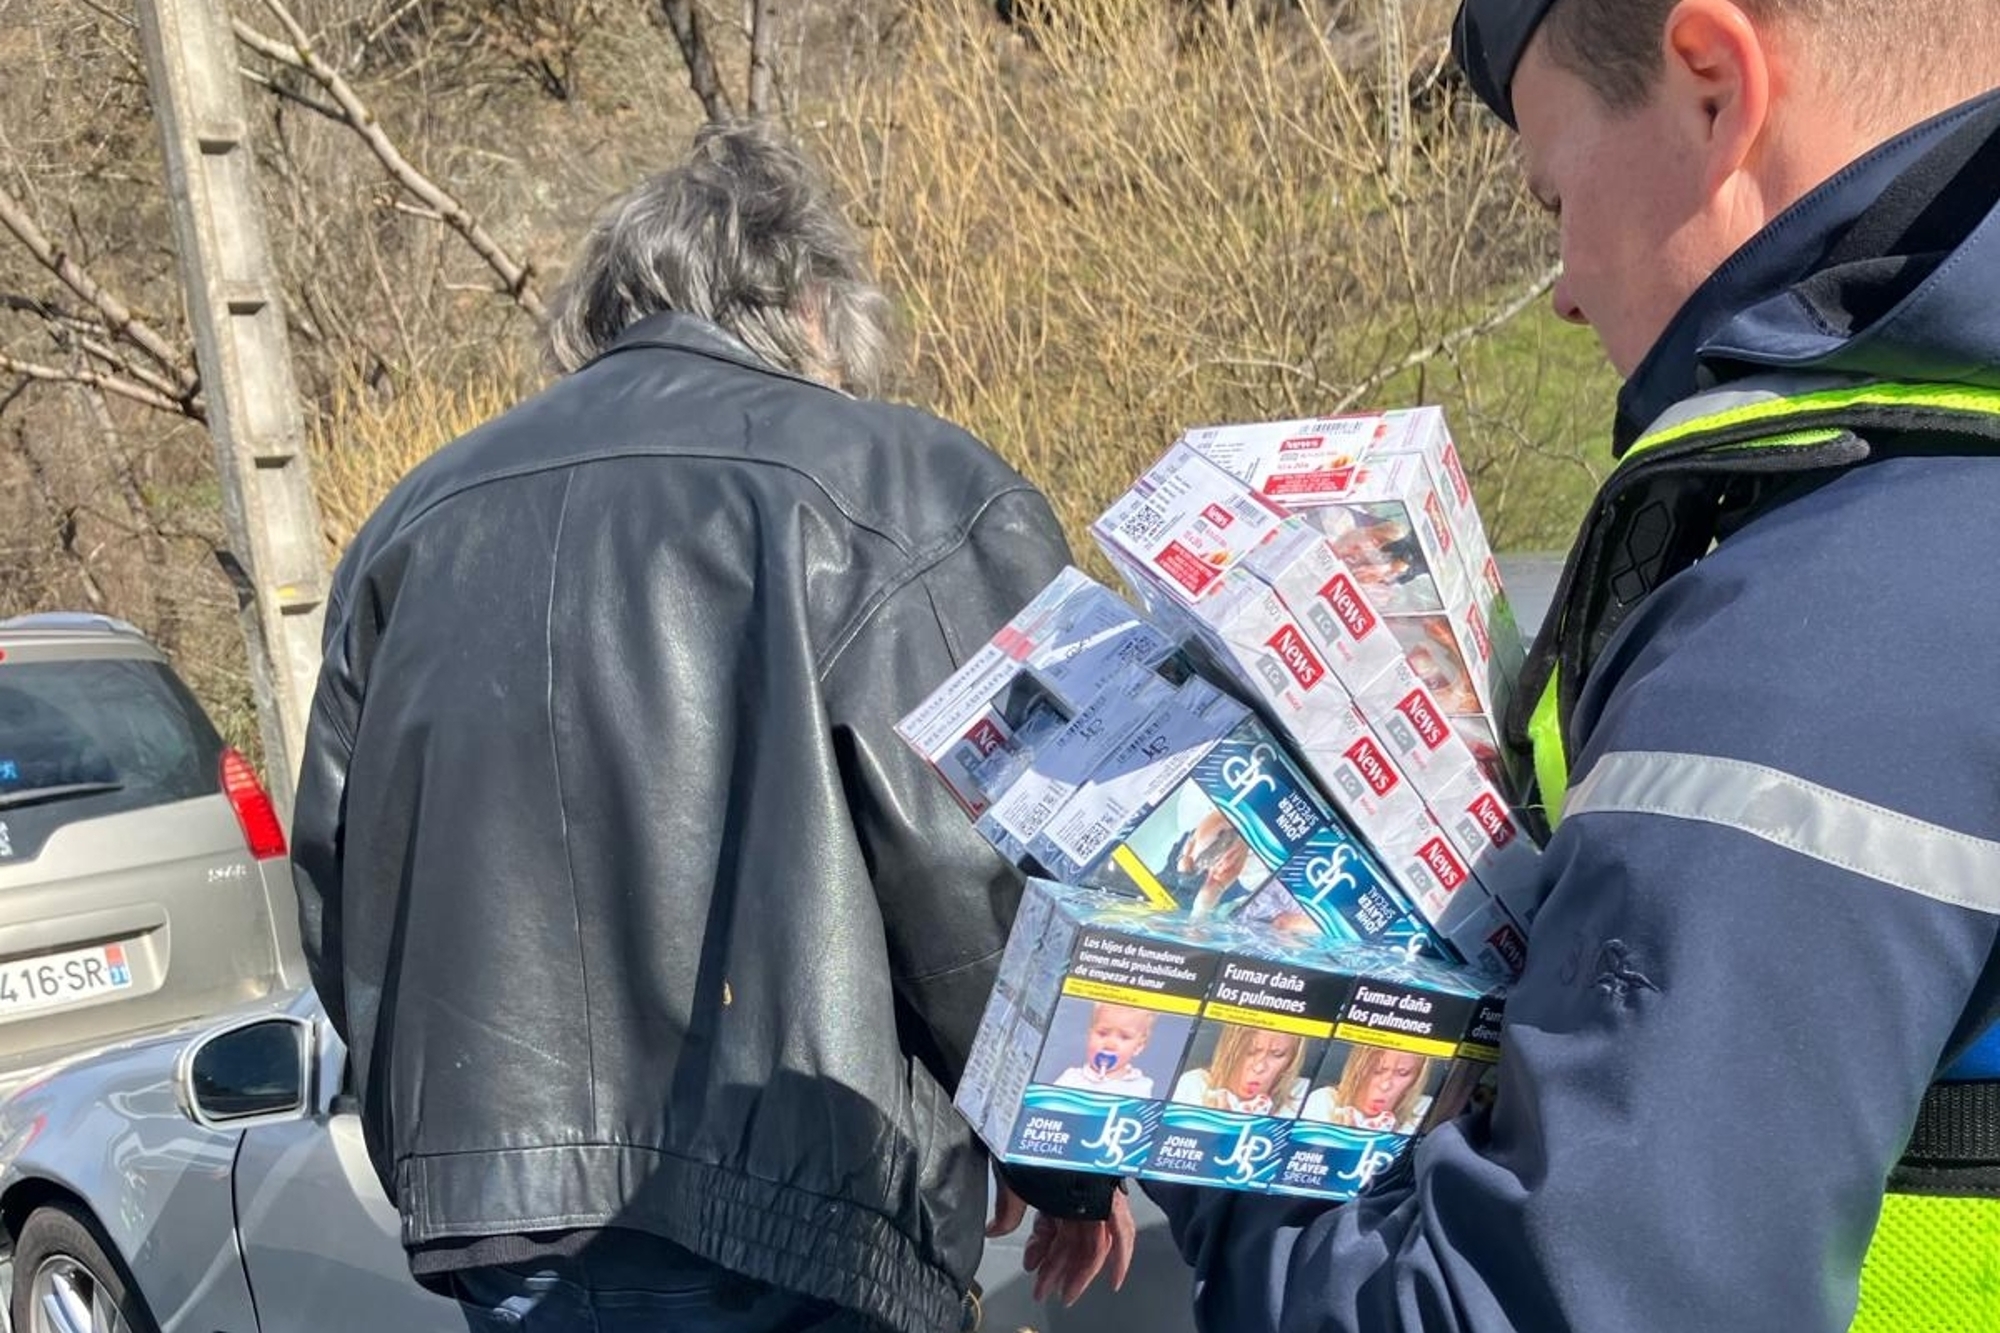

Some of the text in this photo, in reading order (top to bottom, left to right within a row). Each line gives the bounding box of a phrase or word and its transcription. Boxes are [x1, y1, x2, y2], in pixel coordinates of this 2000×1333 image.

[1329, 580, 1367, 634] News
[1276, 630, 1317, 683] News
[1405, 695, 1441, 744] News
[1352, 744, 1390, 791] News
[1277, 799, 1311, 837] PLAYER
[1289, 790, 1319, 828] SPECIAL
[1475, 797, 1510, 844] News
[1275, 814, 1301, 843] JOHN
[1426, 843, 1459, 888] News
[1357, 894, 1388, 929] PLAYER
[1367, 884, 1396, 920] SPECIAL
[1354, 910, 1380, 935] JOHN
[1084, 936, 1186, 965] Los hijos de fumadores
[1075, 965, 1088, 976] de
[1090, 968, 1127, 985] empezar
[1137, 975, 1166, 990] fumar
[1080, 951, 1197, 982] tienen más probabilidades
[1224, 963, 1305, 992] Fumar daña
[1217, 983, 1306, 1013] los pulmones
[1355, 986, 1432, 1014] Fumar daña
[1348, 1006, 1432, 1034] los pulmones
[1479, 1007, 1502, 1023] Fum
[1023, 1129, 1070, 1145] PLAYER
[1026, 1116, 1063, 1132] JOHN
[1018, 1139, 1064, 1156] SPECIAL
[1160, 1145, 1203, 1162] PLAYER
[1164, 1135, 1198, 1150] JOHN
[1291, 1149, 1324, 1164] JOHN
[1155, 1156, 1198, 1172] SPECIAL
[1282, 1170, 1322, 1186] SPECIAL
[1286, 1159, 1329, 1175] PLAYER
